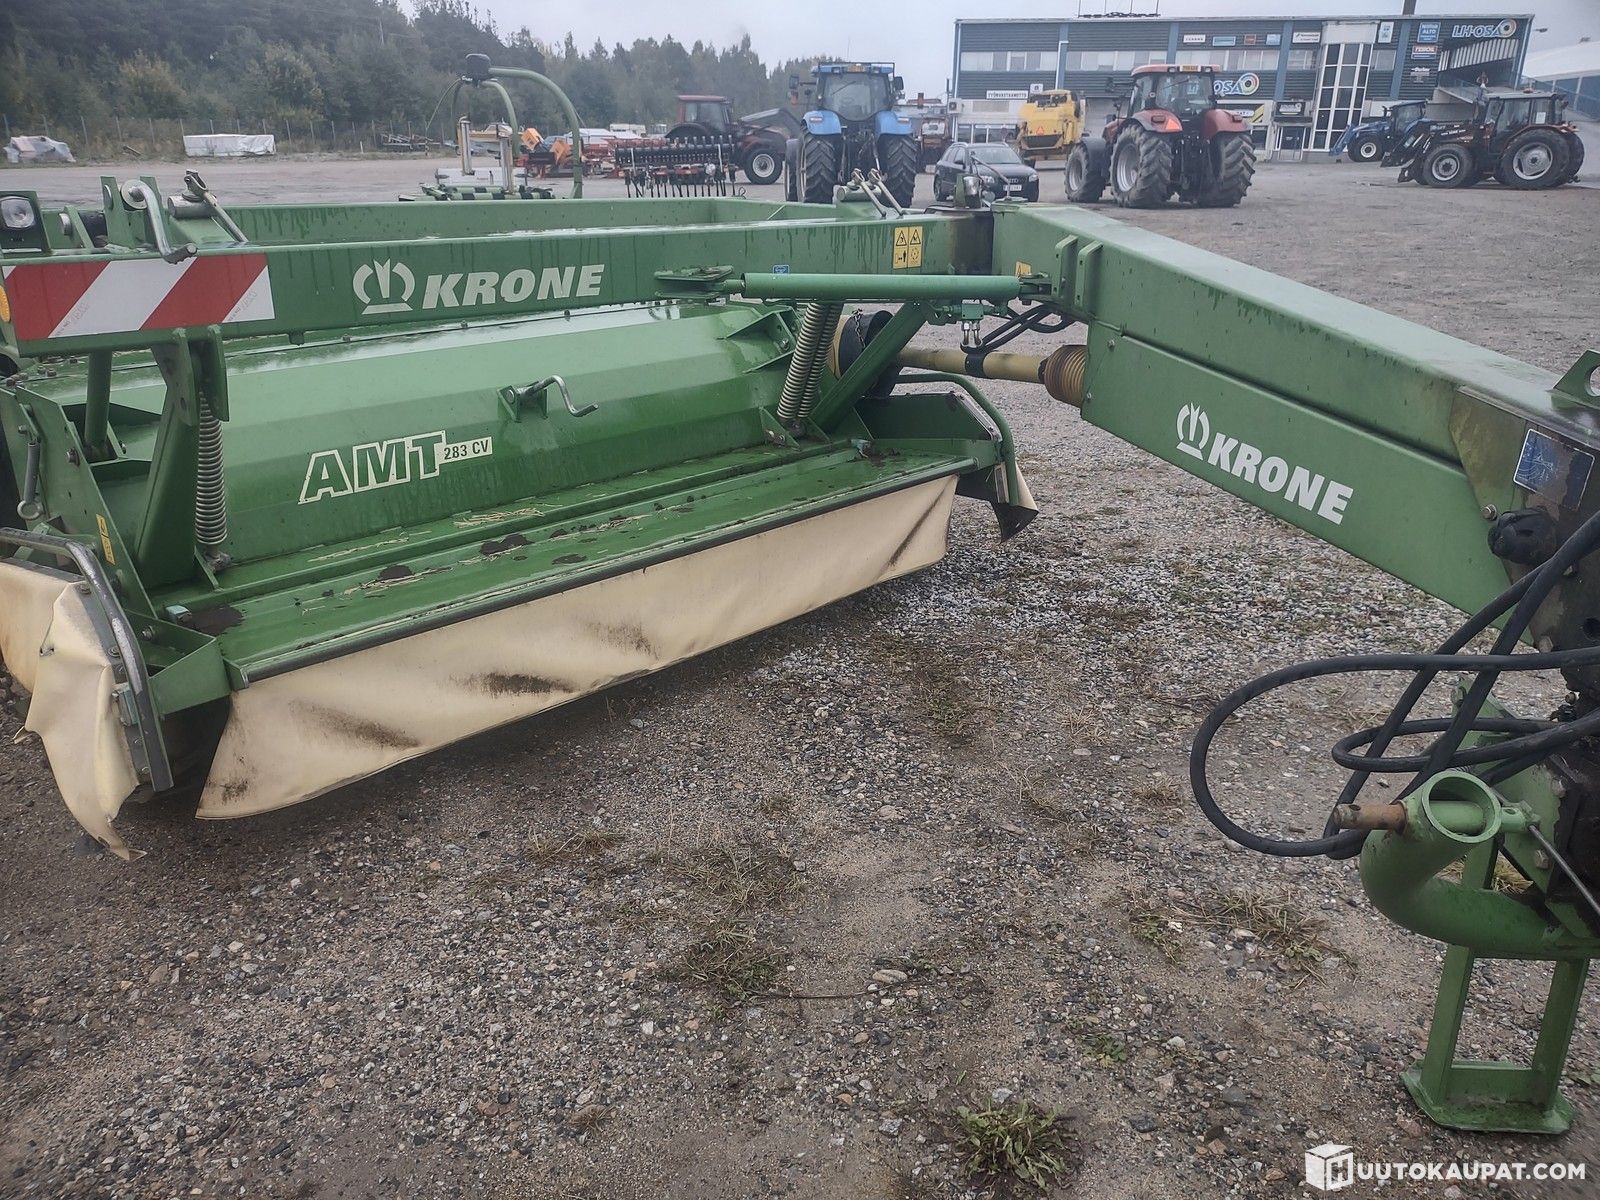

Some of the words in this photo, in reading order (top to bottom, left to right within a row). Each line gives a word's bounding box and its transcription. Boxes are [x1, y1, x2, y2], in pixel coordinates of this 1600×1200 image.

[422, 264, 605, 310] KRONE
[298, 430, 447, 505] AMT
[444, 445, 468, 460] 283
[473, 440, 490, 454] CV
[1208, 432, 1354, 526] KRONE
